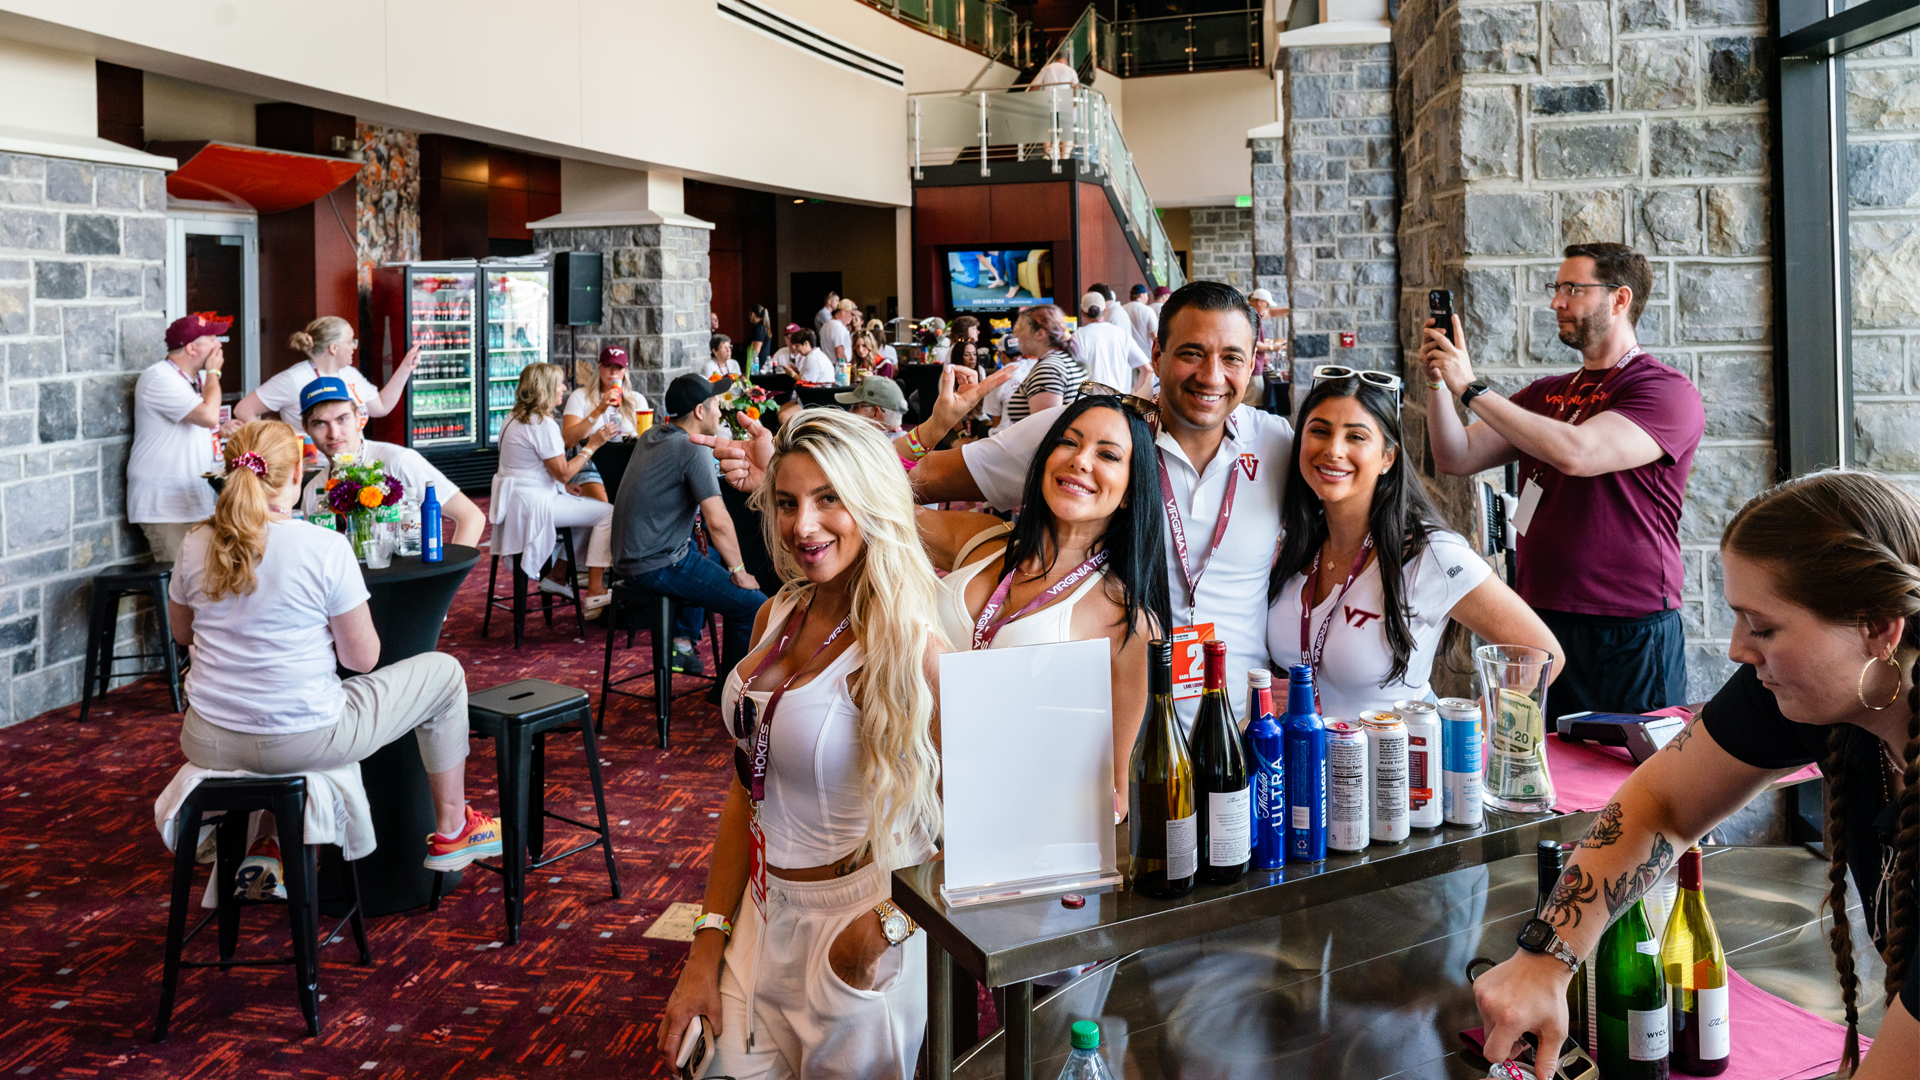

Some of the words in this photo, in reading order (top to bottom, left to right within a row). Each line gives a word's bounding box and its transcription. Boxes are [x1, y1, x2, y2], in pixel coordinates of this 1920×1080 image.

[608, 348, 625, 356] VT
[1166, 498, 1186, 551] VIRGINIA
[1046, 563, 1093, 595] VIRGINIA
[973, 603, 998, 650] VIRGINIA
[1343, 604, 1382, 629] VT
[1313, 616, 1331, 664] VIRGINIA
[1186, 643, 1204, 679] 2
[754, 724, 770, 778] HOKIES
[1514, 730, 1530, 744] 20
[1257, 772, 1269, 818] Michelob
[1271, 755, 1284, 827] ULTRA
[469, 830, 496, 843] HOKA
